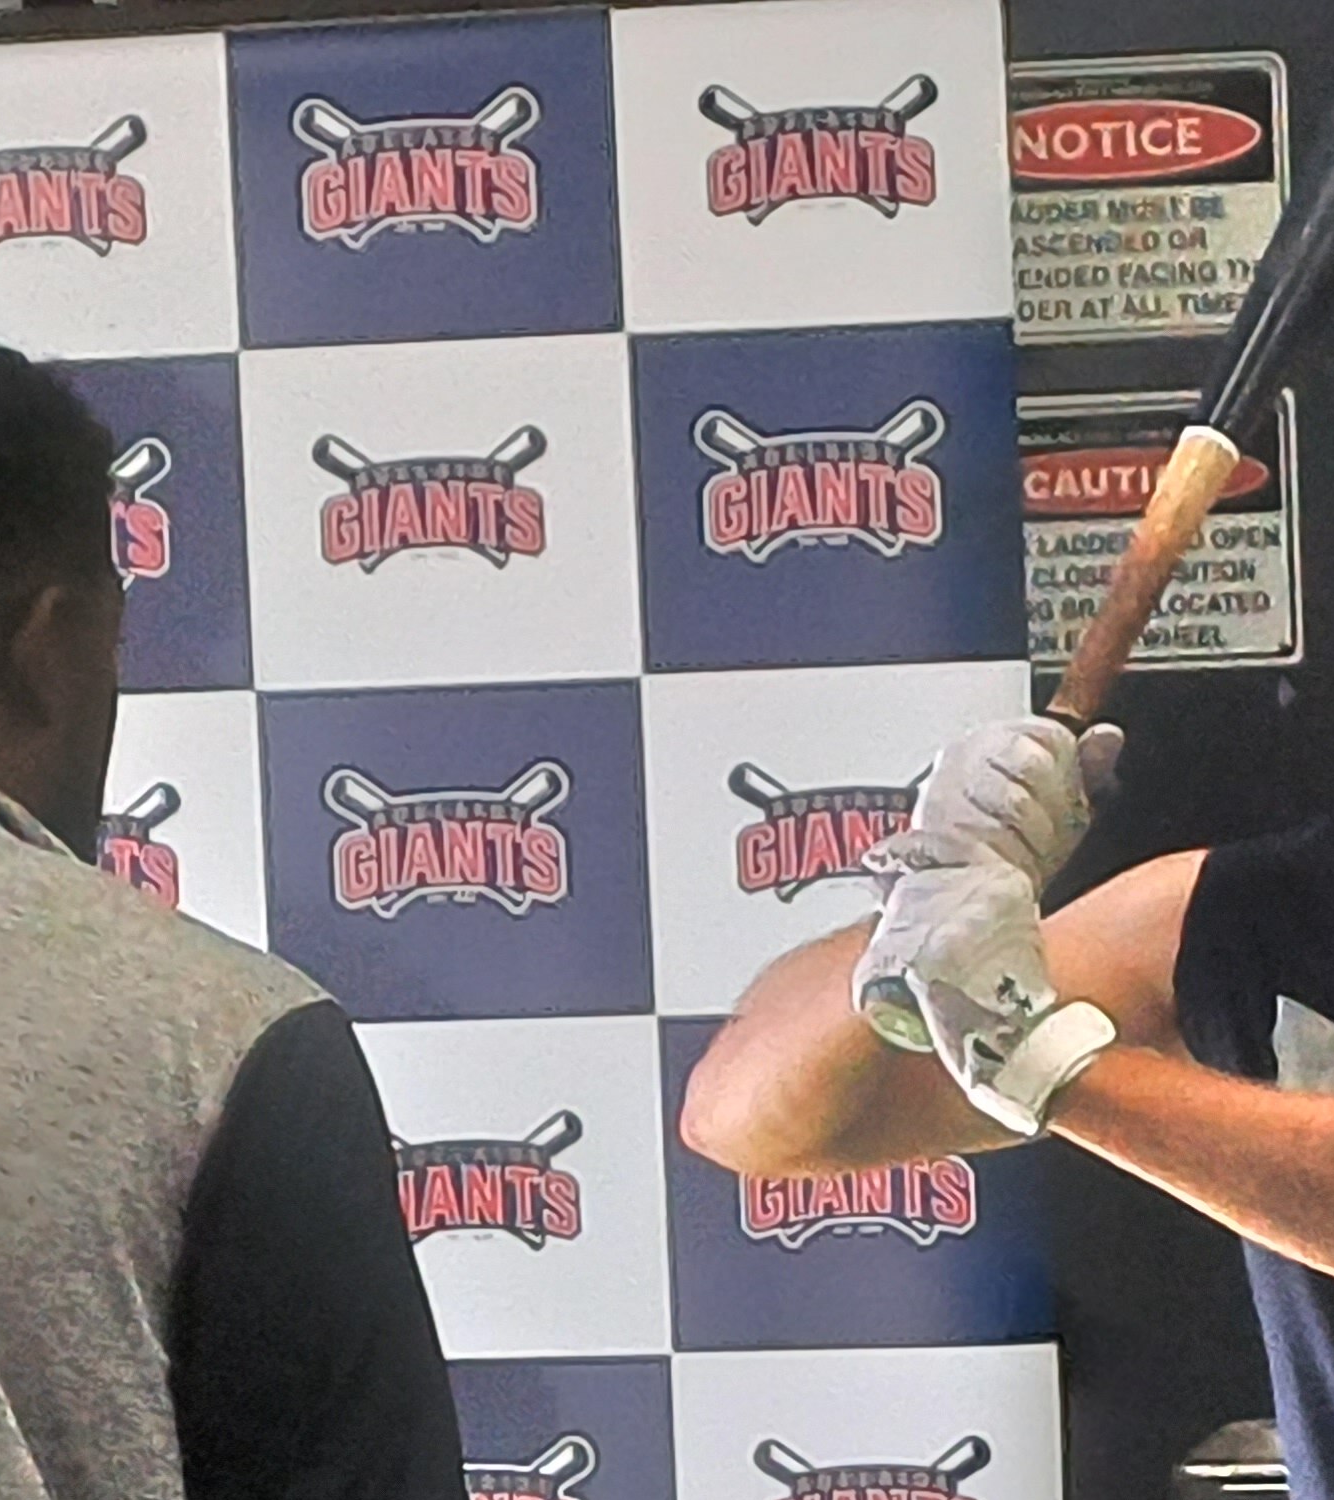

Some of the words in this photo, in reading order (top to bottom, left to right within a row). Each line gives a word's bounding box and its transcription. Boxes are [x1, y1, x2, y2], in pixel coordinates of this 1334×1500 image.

[707, 129, 936, 216] GIANTS
[1013, 116, 1203, 161] NOTICE
[309, 148, 532, 231] GIANTS
[1017, 264, 1111, 290] ENDED
[1017, 299, 1073, 322] DER
[709, 462, 936, 545] GIANTS
[1023, 464, 1152, 499] CAUTI
[321, 480, 546, 565] GIANTS
[340, 818, 561, 900] GIANTS
[736, 810, 912, 893] GIAN
[397, 1163, 581, 1241] IANTS
[747, 1158, 970, 1231] GIANTS
